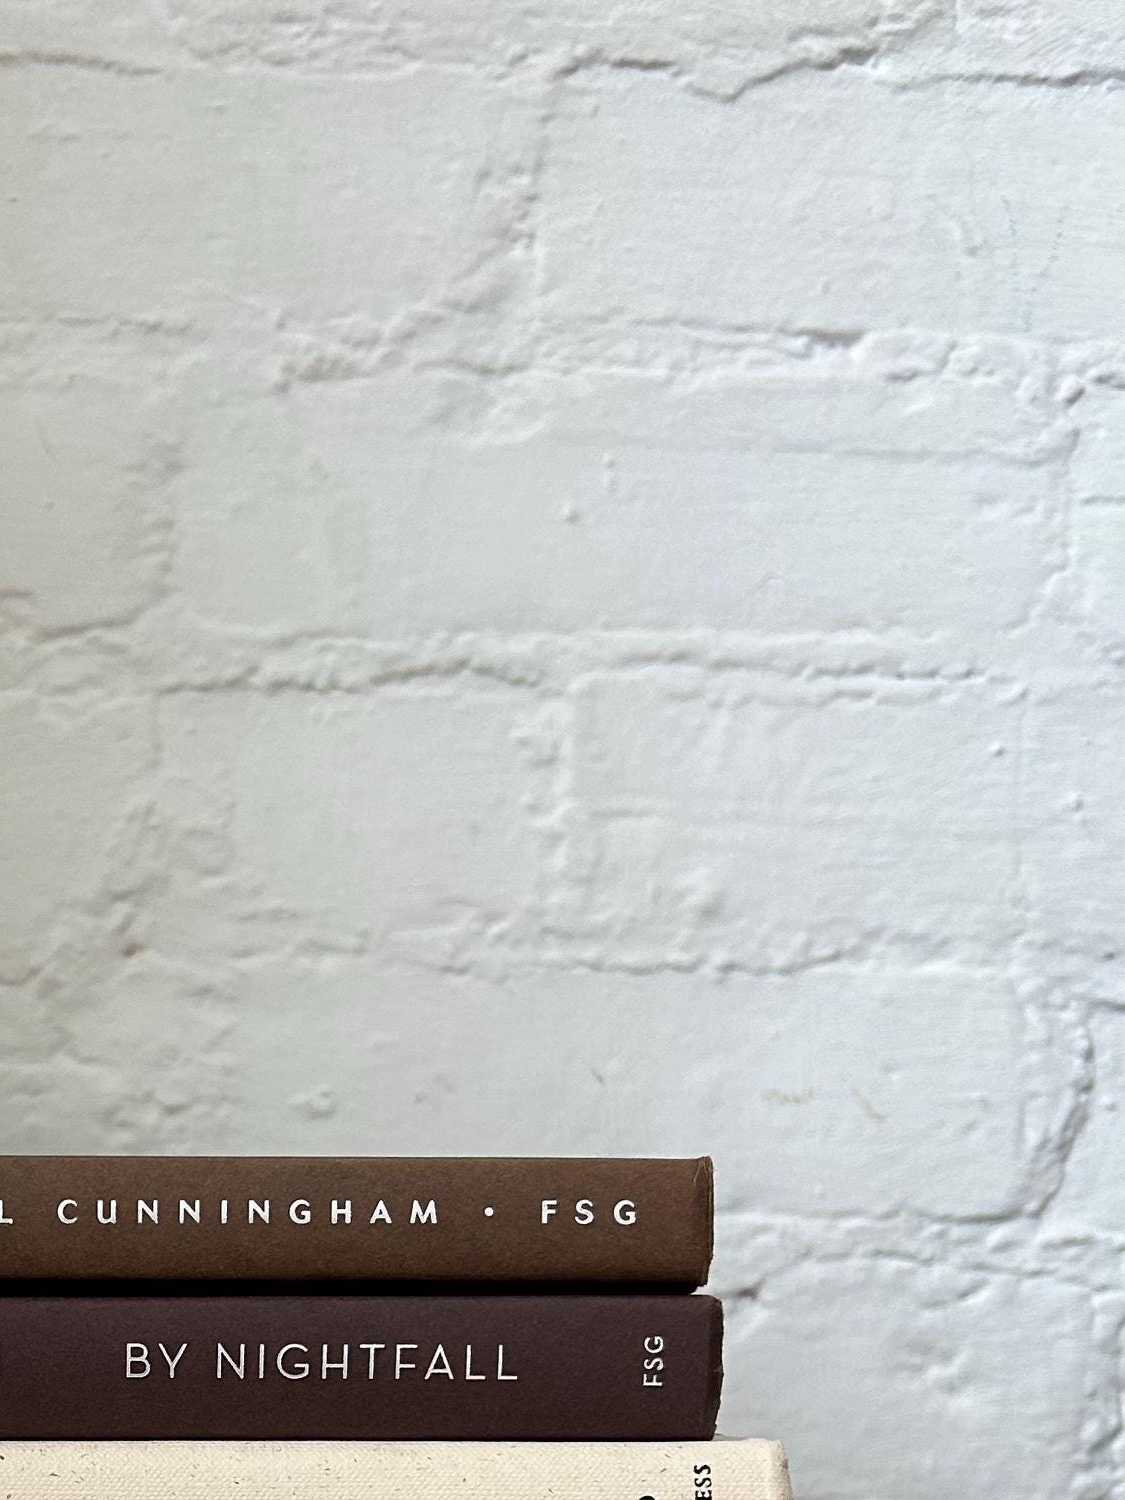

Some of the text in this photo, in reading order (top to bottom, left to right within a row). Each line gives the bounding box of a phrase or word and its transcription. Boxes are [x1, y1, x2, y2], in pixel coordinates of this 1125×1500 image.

[57, 1199, 438, 1224] CUNNINGHAM
[541, 1199, 637, 1226] FSG
[125, 1342, 518, 1380] BY NIGHTFALL
[642, 1335, 664, 1387] FSG
